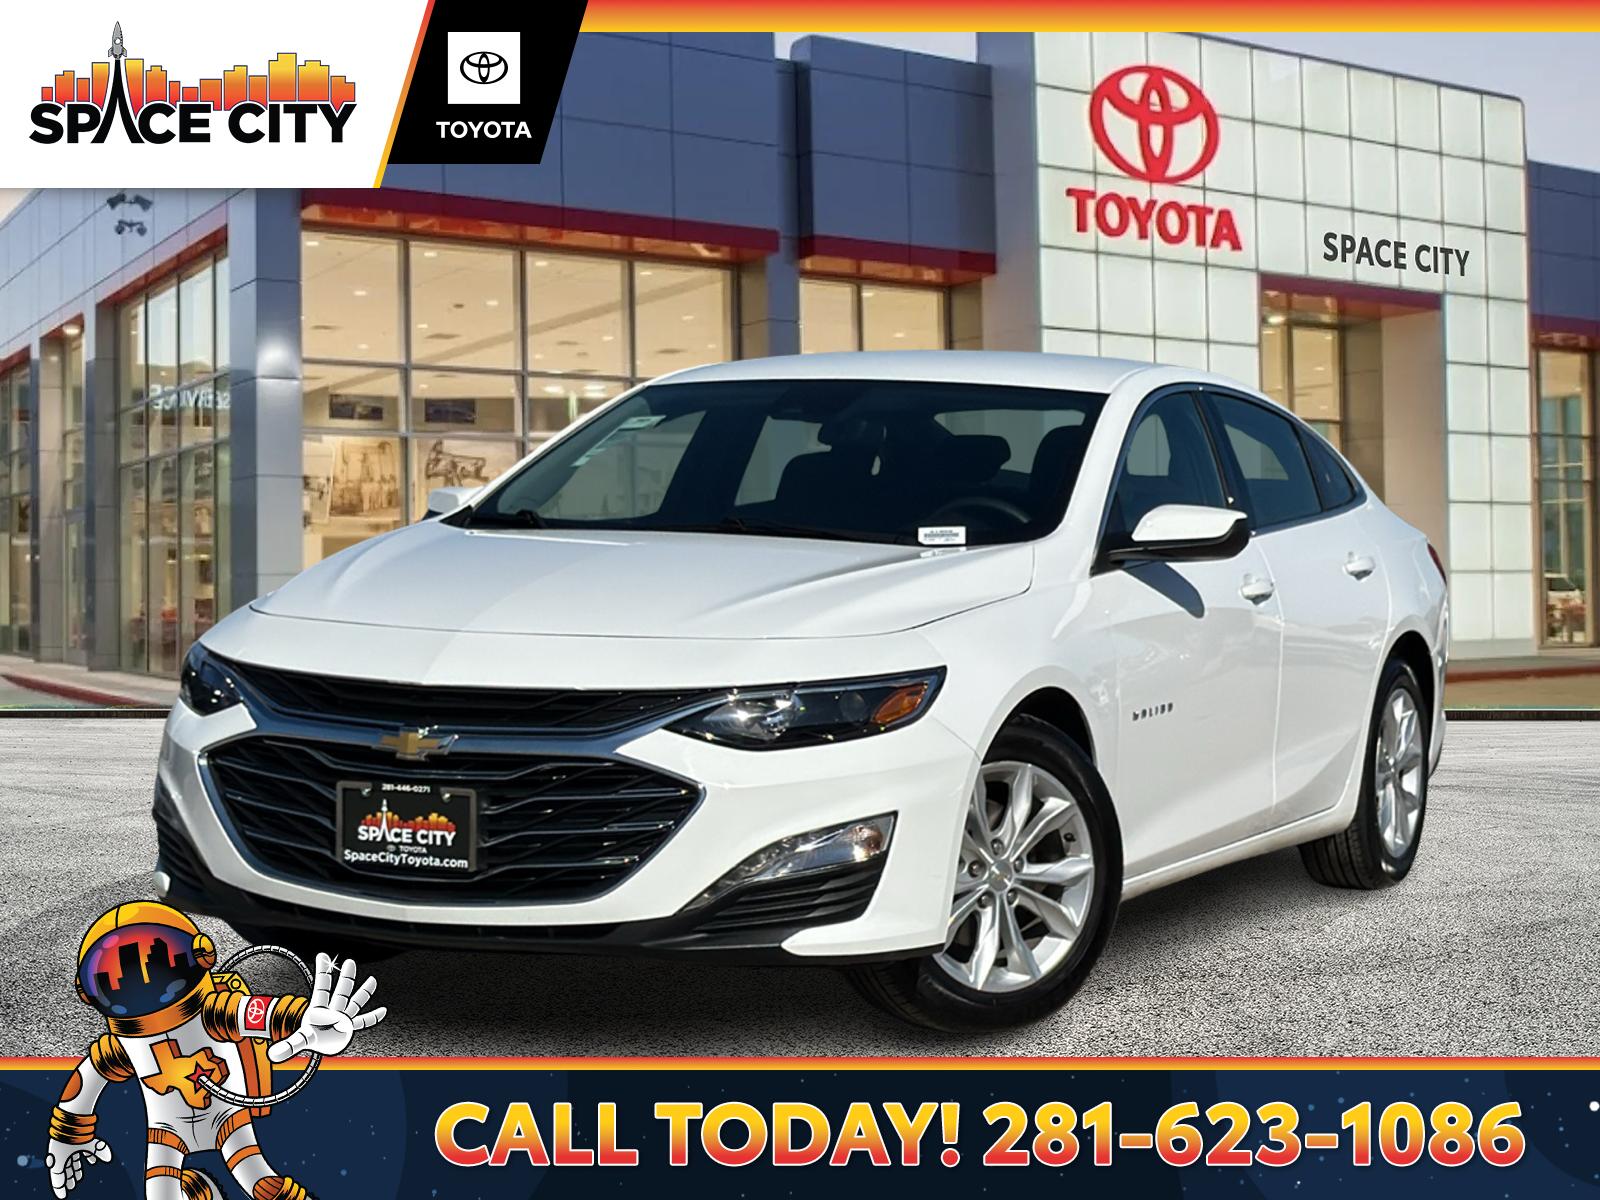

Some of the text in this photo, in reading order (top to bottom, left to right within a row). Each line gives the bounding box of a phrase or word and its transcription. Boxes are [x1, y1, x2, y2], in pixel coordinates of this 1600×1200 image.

[1066, 187, 1243, 251] TOYOTA
[1322, 232, 1470, 277] SPACE CITY
[357, 813, 456, 846] SPACE CITY
[343, 849, 469, 869] SpaceCityToyota.com
